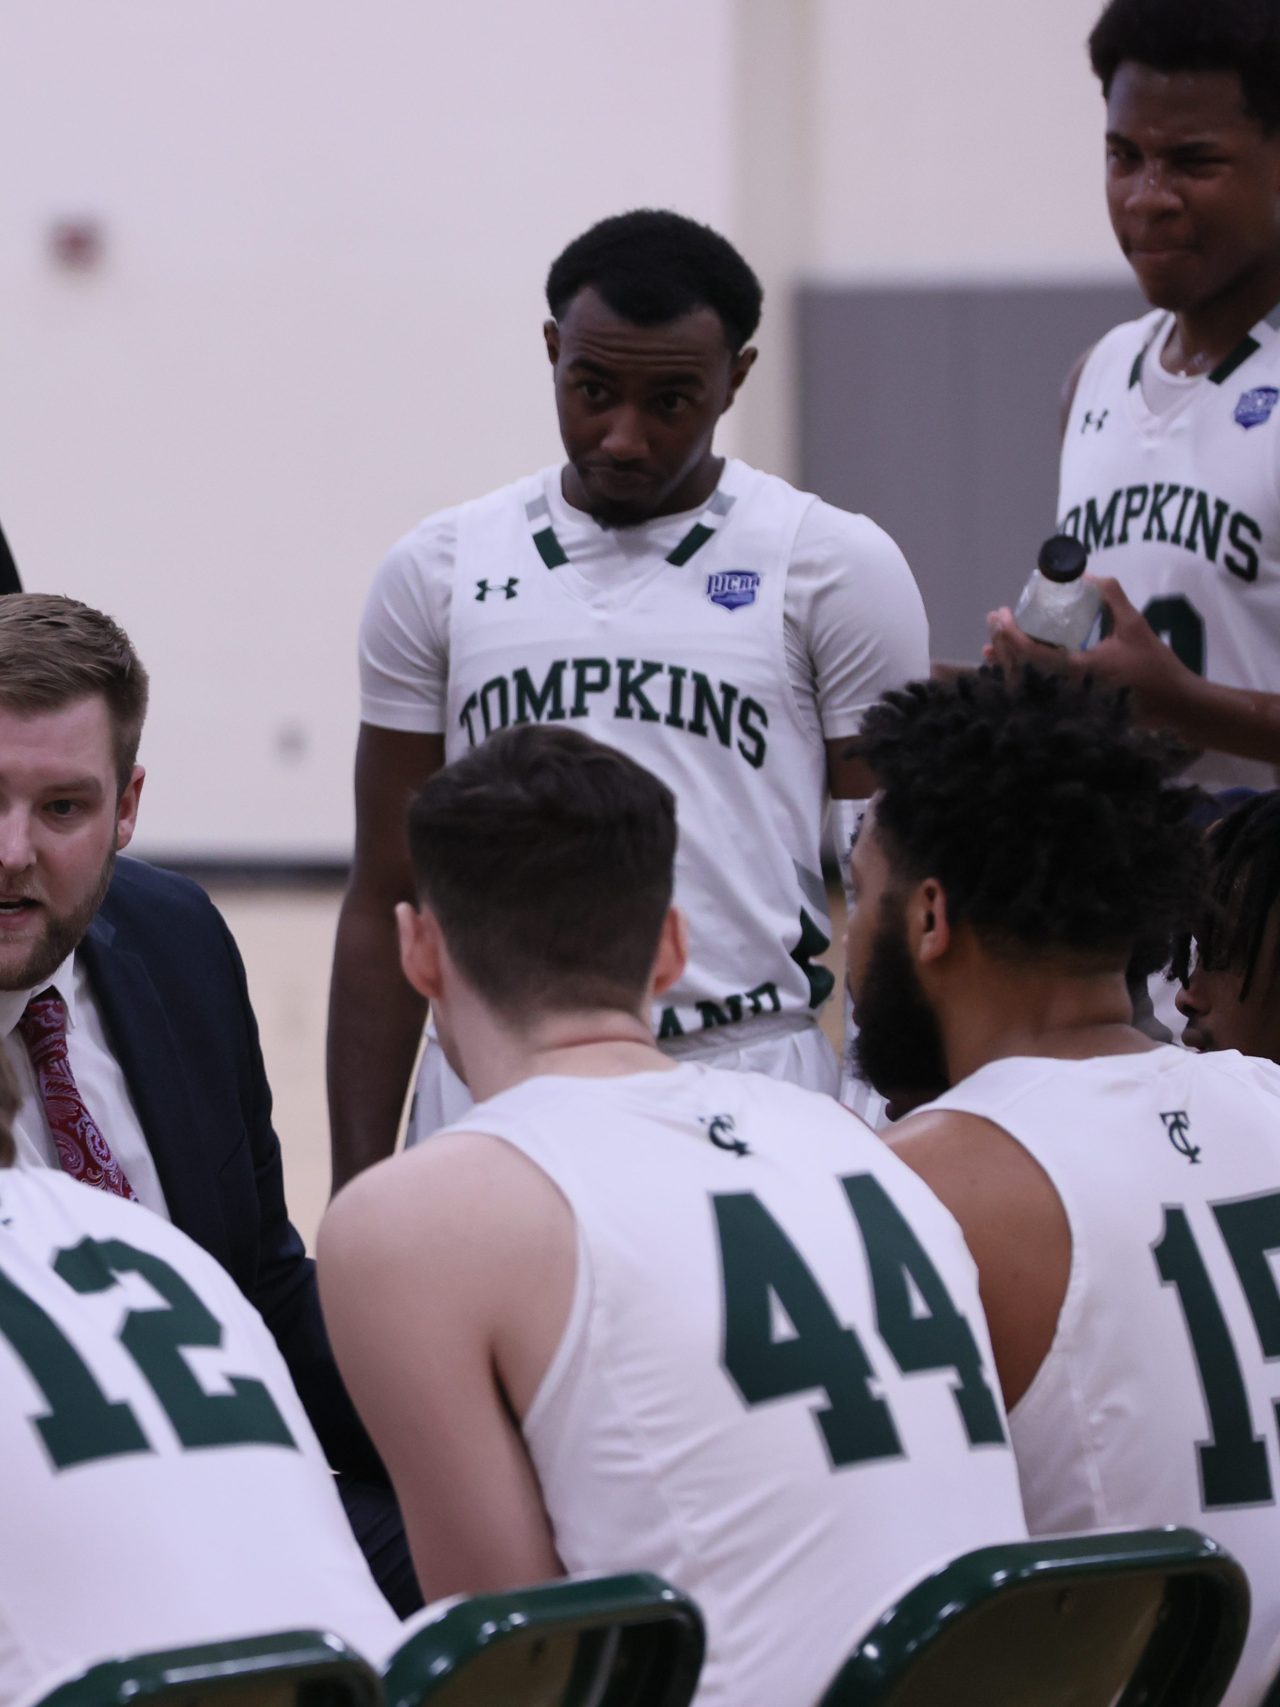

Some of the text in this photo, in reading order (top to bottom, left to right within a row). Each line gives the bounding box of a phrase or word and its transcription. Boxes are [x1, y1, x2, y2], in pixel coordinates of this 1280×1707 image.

[1058, 483, 1263, 583] OMPKINS
[459, 657, 768, 770] TOMPKINS
[710, 1173, 1007, 1470] 44
